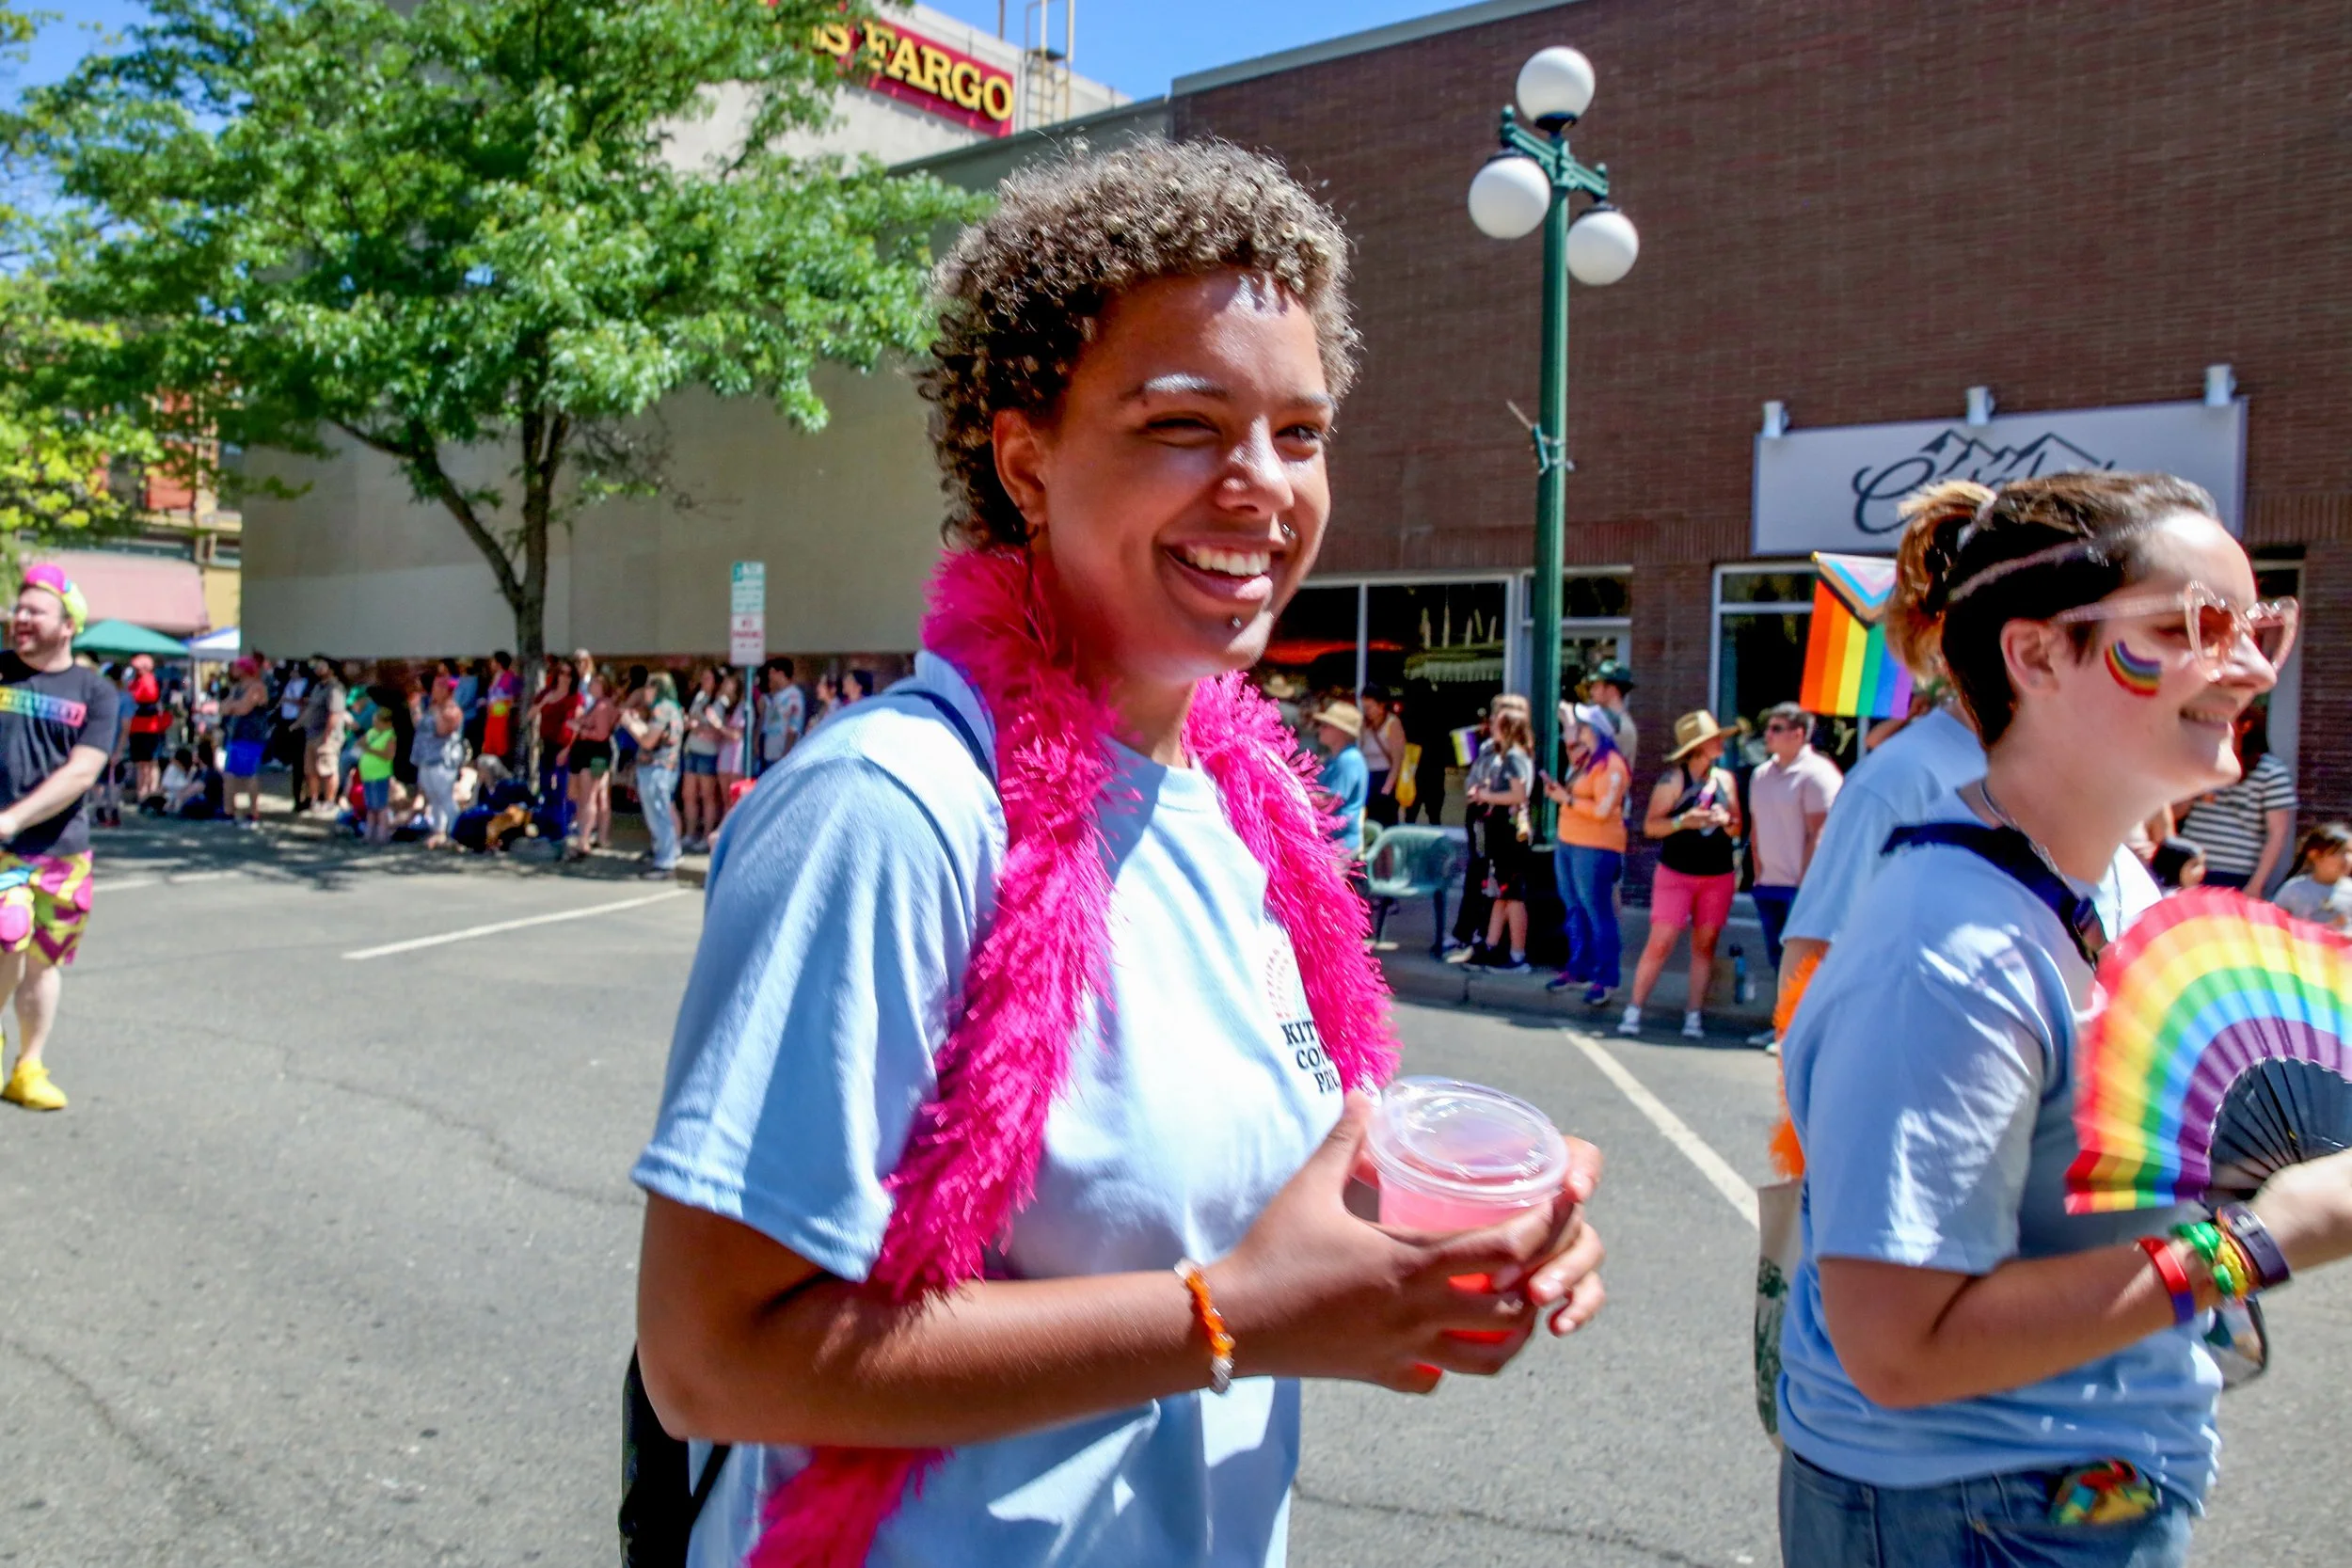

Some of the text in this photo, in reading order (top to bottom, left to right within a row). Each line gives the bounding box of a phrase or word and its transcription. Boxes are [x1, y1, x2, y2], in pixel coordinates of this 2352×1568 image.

[862, 19, 1014, 121] FARGO
[1279, 1021, 1316, 1046] KIT
[1295, 1046, 1327, 1070] CO
